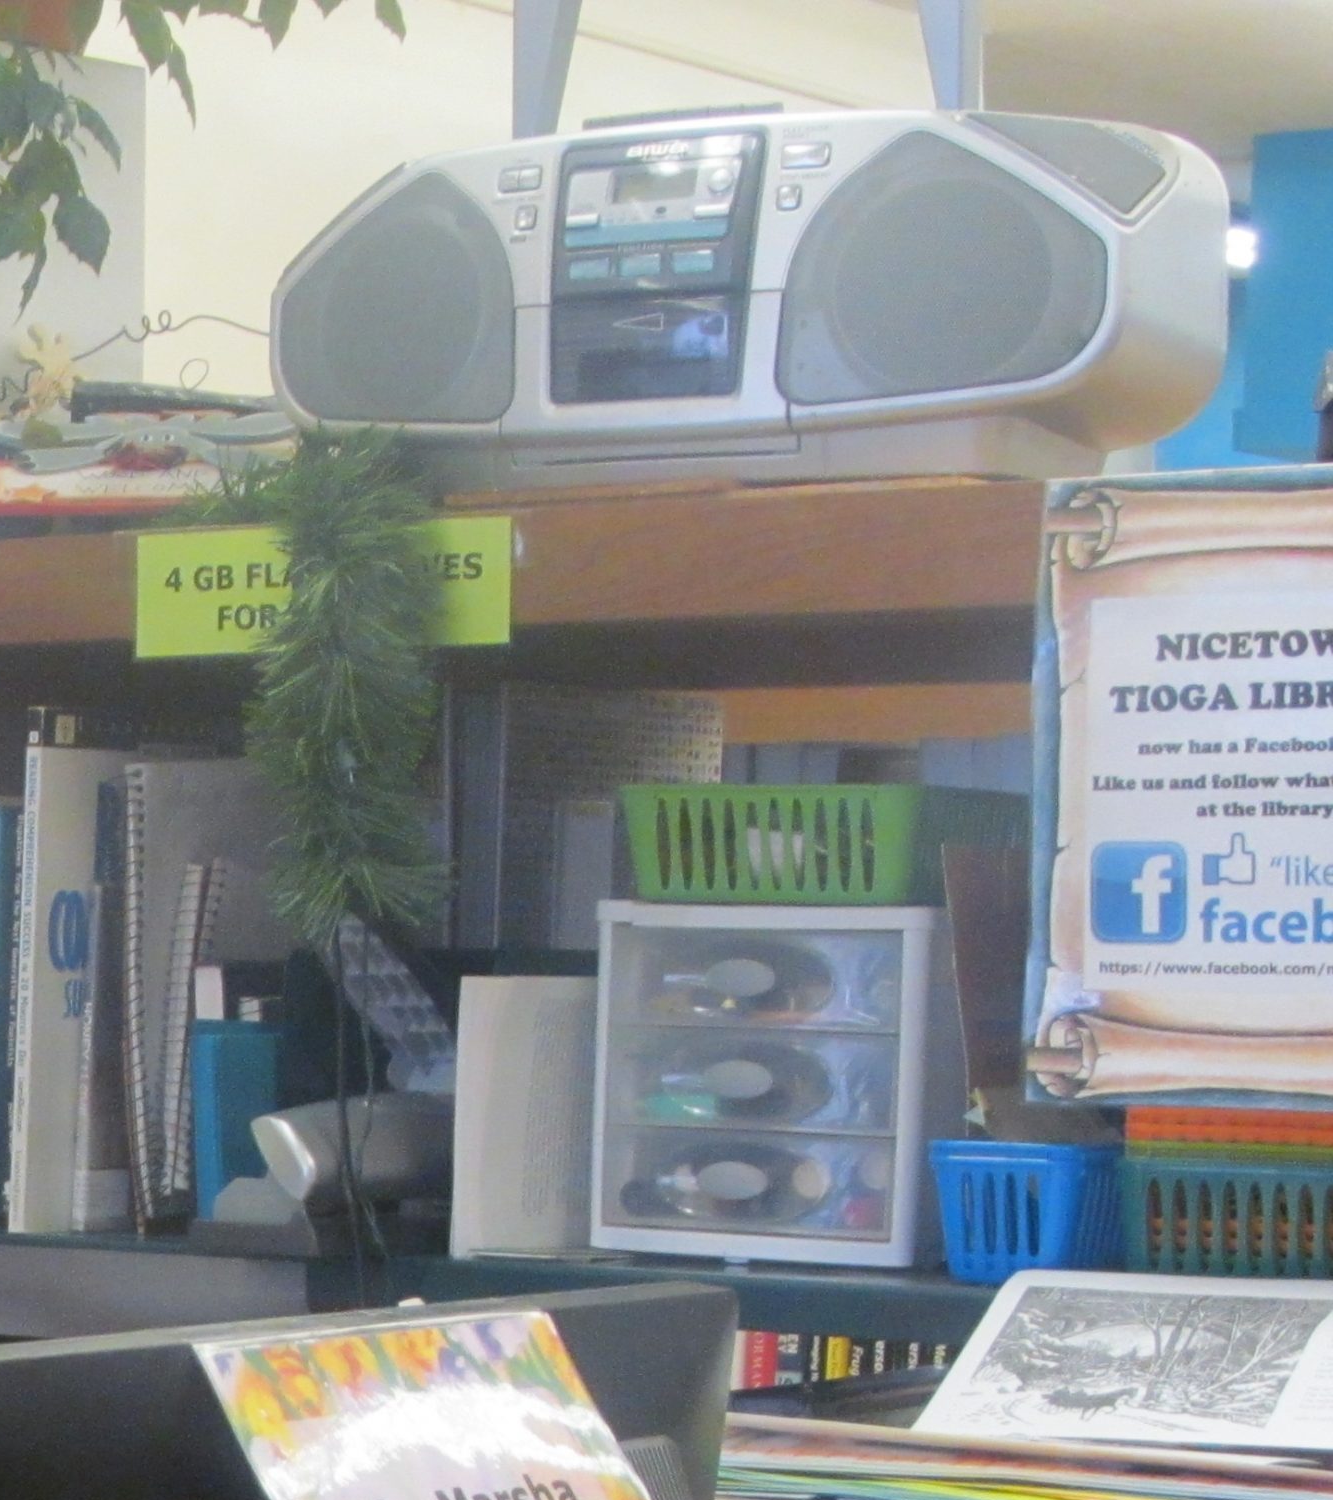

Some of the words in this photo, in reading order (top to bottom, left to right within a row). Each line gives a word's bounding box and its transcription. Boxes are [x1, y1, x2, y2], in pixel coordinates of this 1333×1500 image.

[165, 568, 182, 591] 4
[193, 565, 234, 590] GB
[1156, 629, 1333, 661] NICETOW
[1109, 683, 1238, 713] TIOGA
[1138, 741, 1183, 755] now
[1188, 738, 1224, 754] has
[1228, 741, 1239, 753] a
[29, 756, 39, 806] READING
[1093, 775, 1137, 791] Like
[1141, 778, 1165, 791] us
[1169, 775, 1207, 790] and
[1211, 774, 1280, 790] follow
[1196, 804, 1218, 817] at
[1222, 802, 1257, 817] the
[1261, 800, 1333, 819] library
[23, 811, 37, 907] COMPREHENSION
[23, 911, 33, 958] SUCCESS
[19, 977, 30, 992] 20
[18, 996, 29, 1036] Minutes
[16, 1048, 27, 1068] Day
